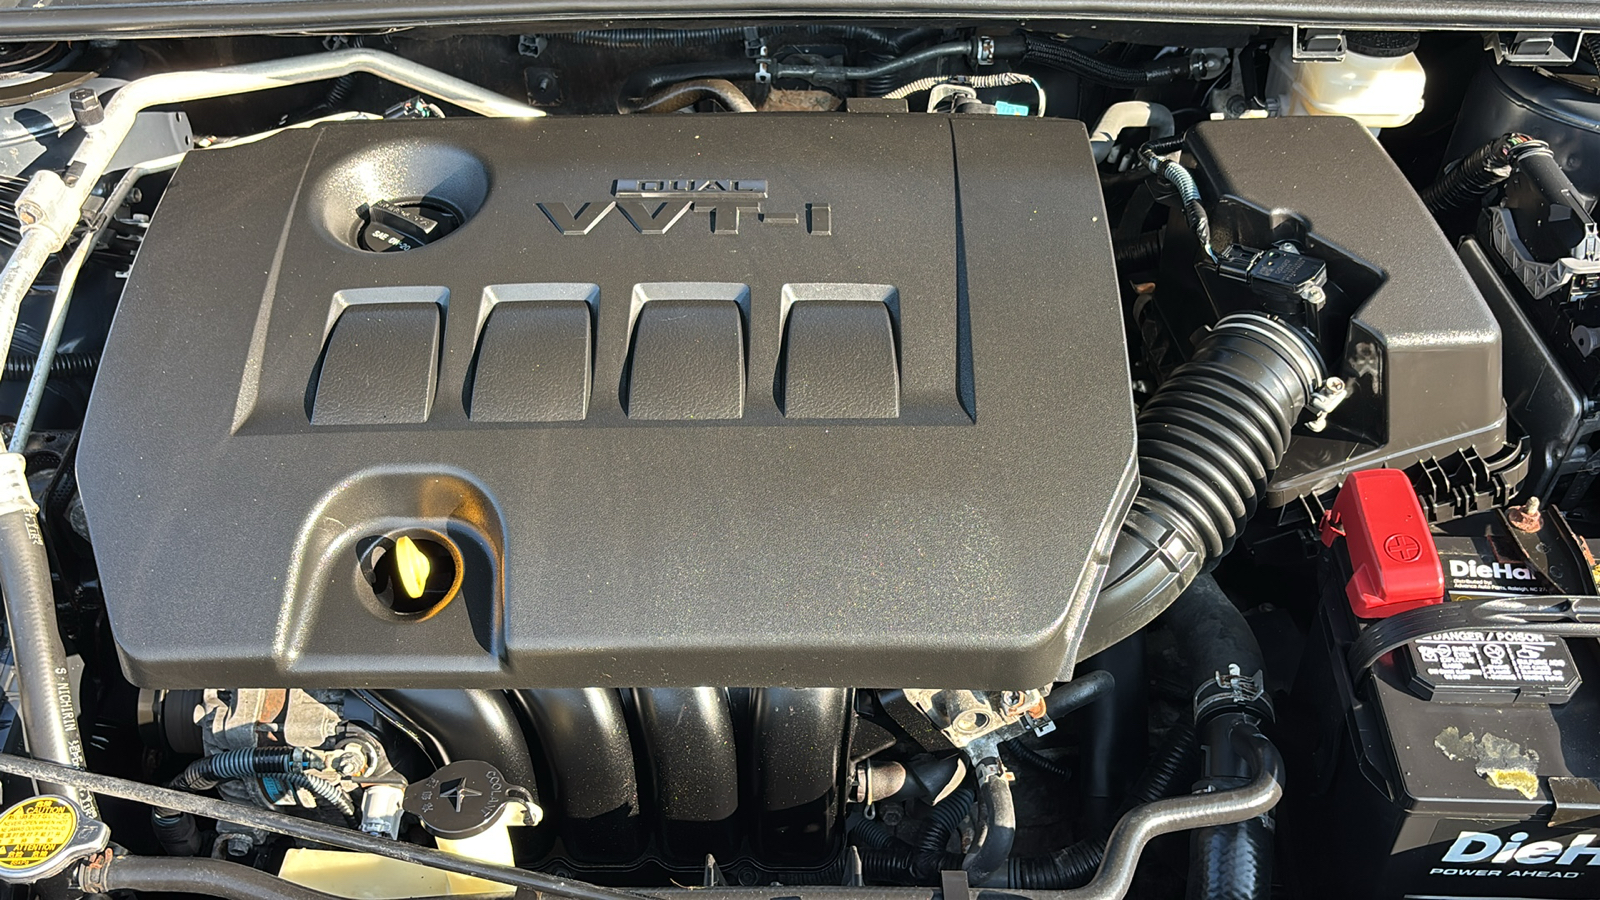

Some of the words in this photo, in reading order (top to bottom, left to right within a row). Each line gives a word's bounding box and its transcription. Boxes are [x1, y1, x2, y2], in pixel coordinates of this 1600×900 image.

[637, 180, 754, 191] DUAL
[371, 229, 389, 241] SAE
[1496, 632, 1545, 643] POISON
[57, 682, 77, 732] NICHIRIN
[481, 770, 502, 818] COOLANT
[26, 806, 66, 814] CAUTION
[1429, 868, 1502, 876] POWER
